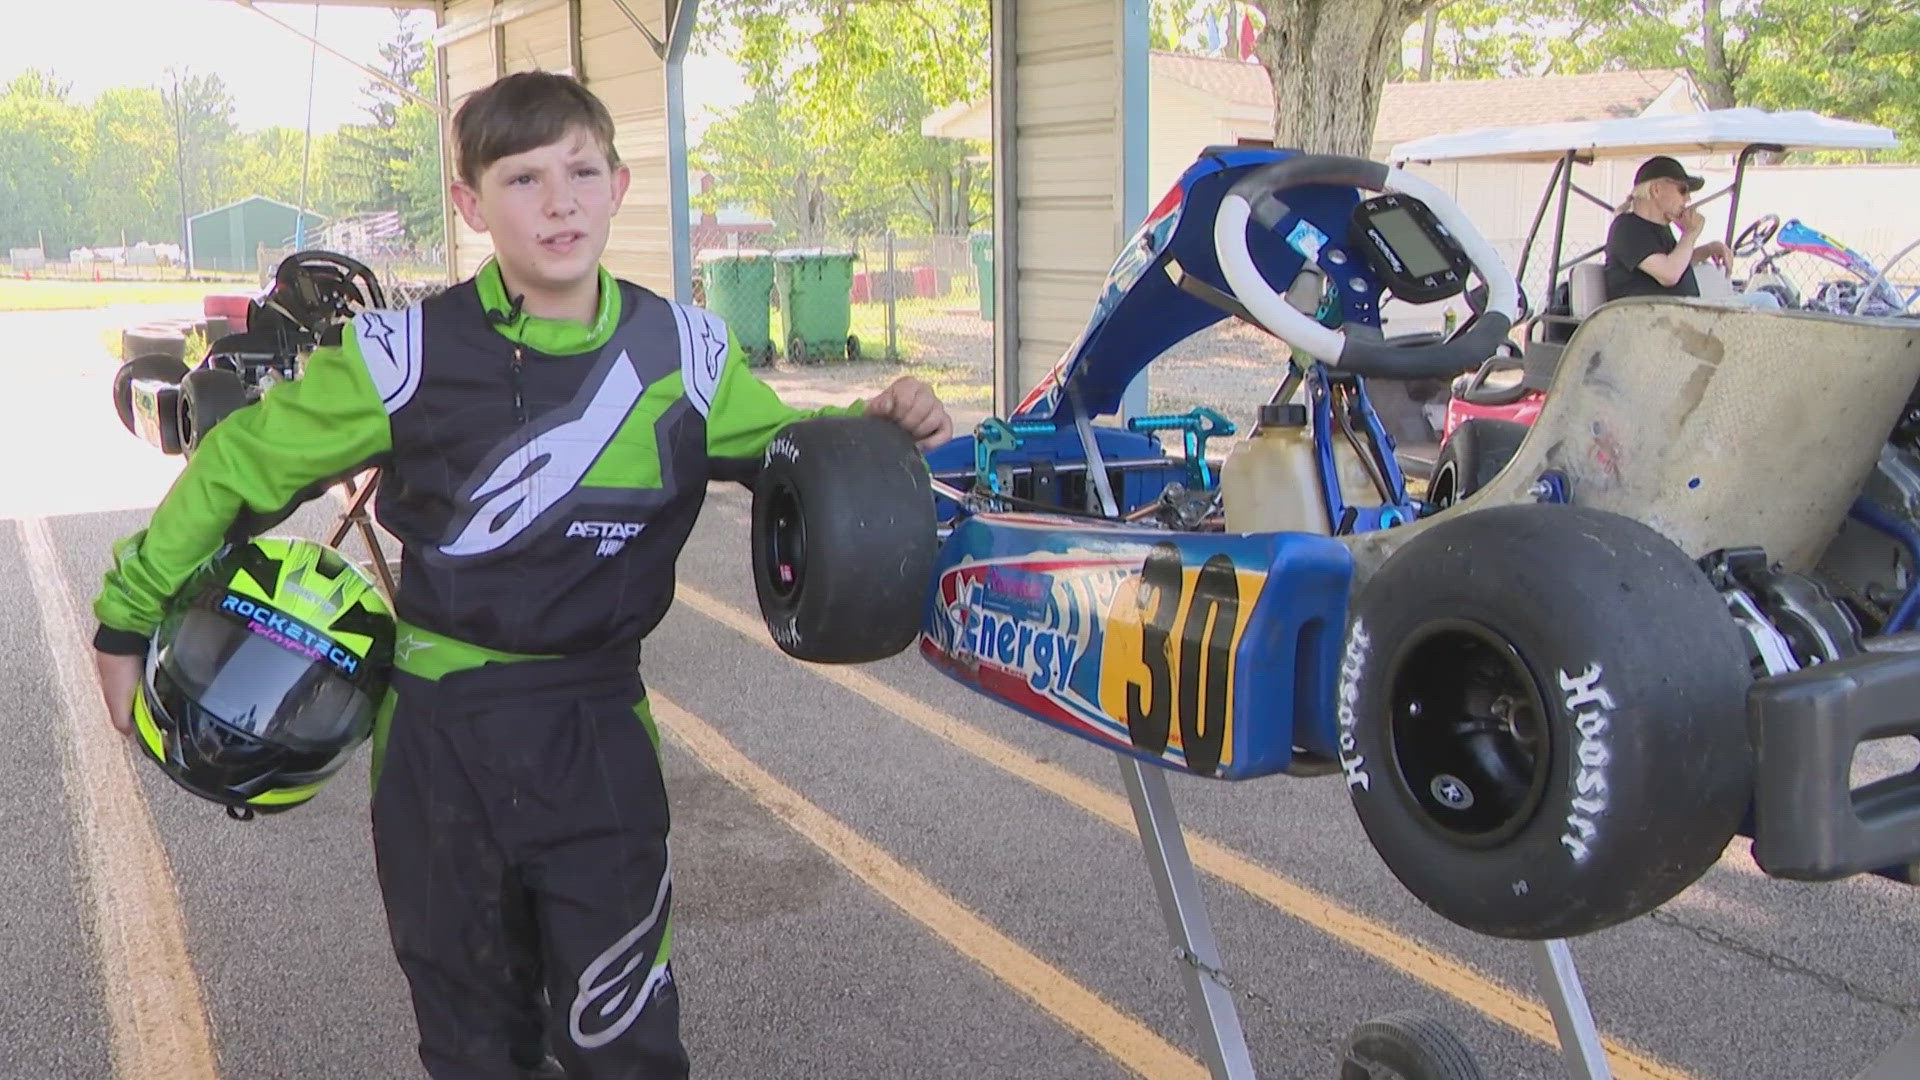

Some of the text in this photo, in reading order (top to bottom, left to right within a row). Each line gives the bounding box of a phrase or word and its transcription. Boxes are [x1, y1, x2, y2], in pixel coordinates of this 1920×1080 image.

[222, 595, 358, 674] ROCKETECH
[964, 584, 1078, 693] Energy
[1126, 541, 1239, 777] 30
[1558, 660, 1616, 862] Hoosier
